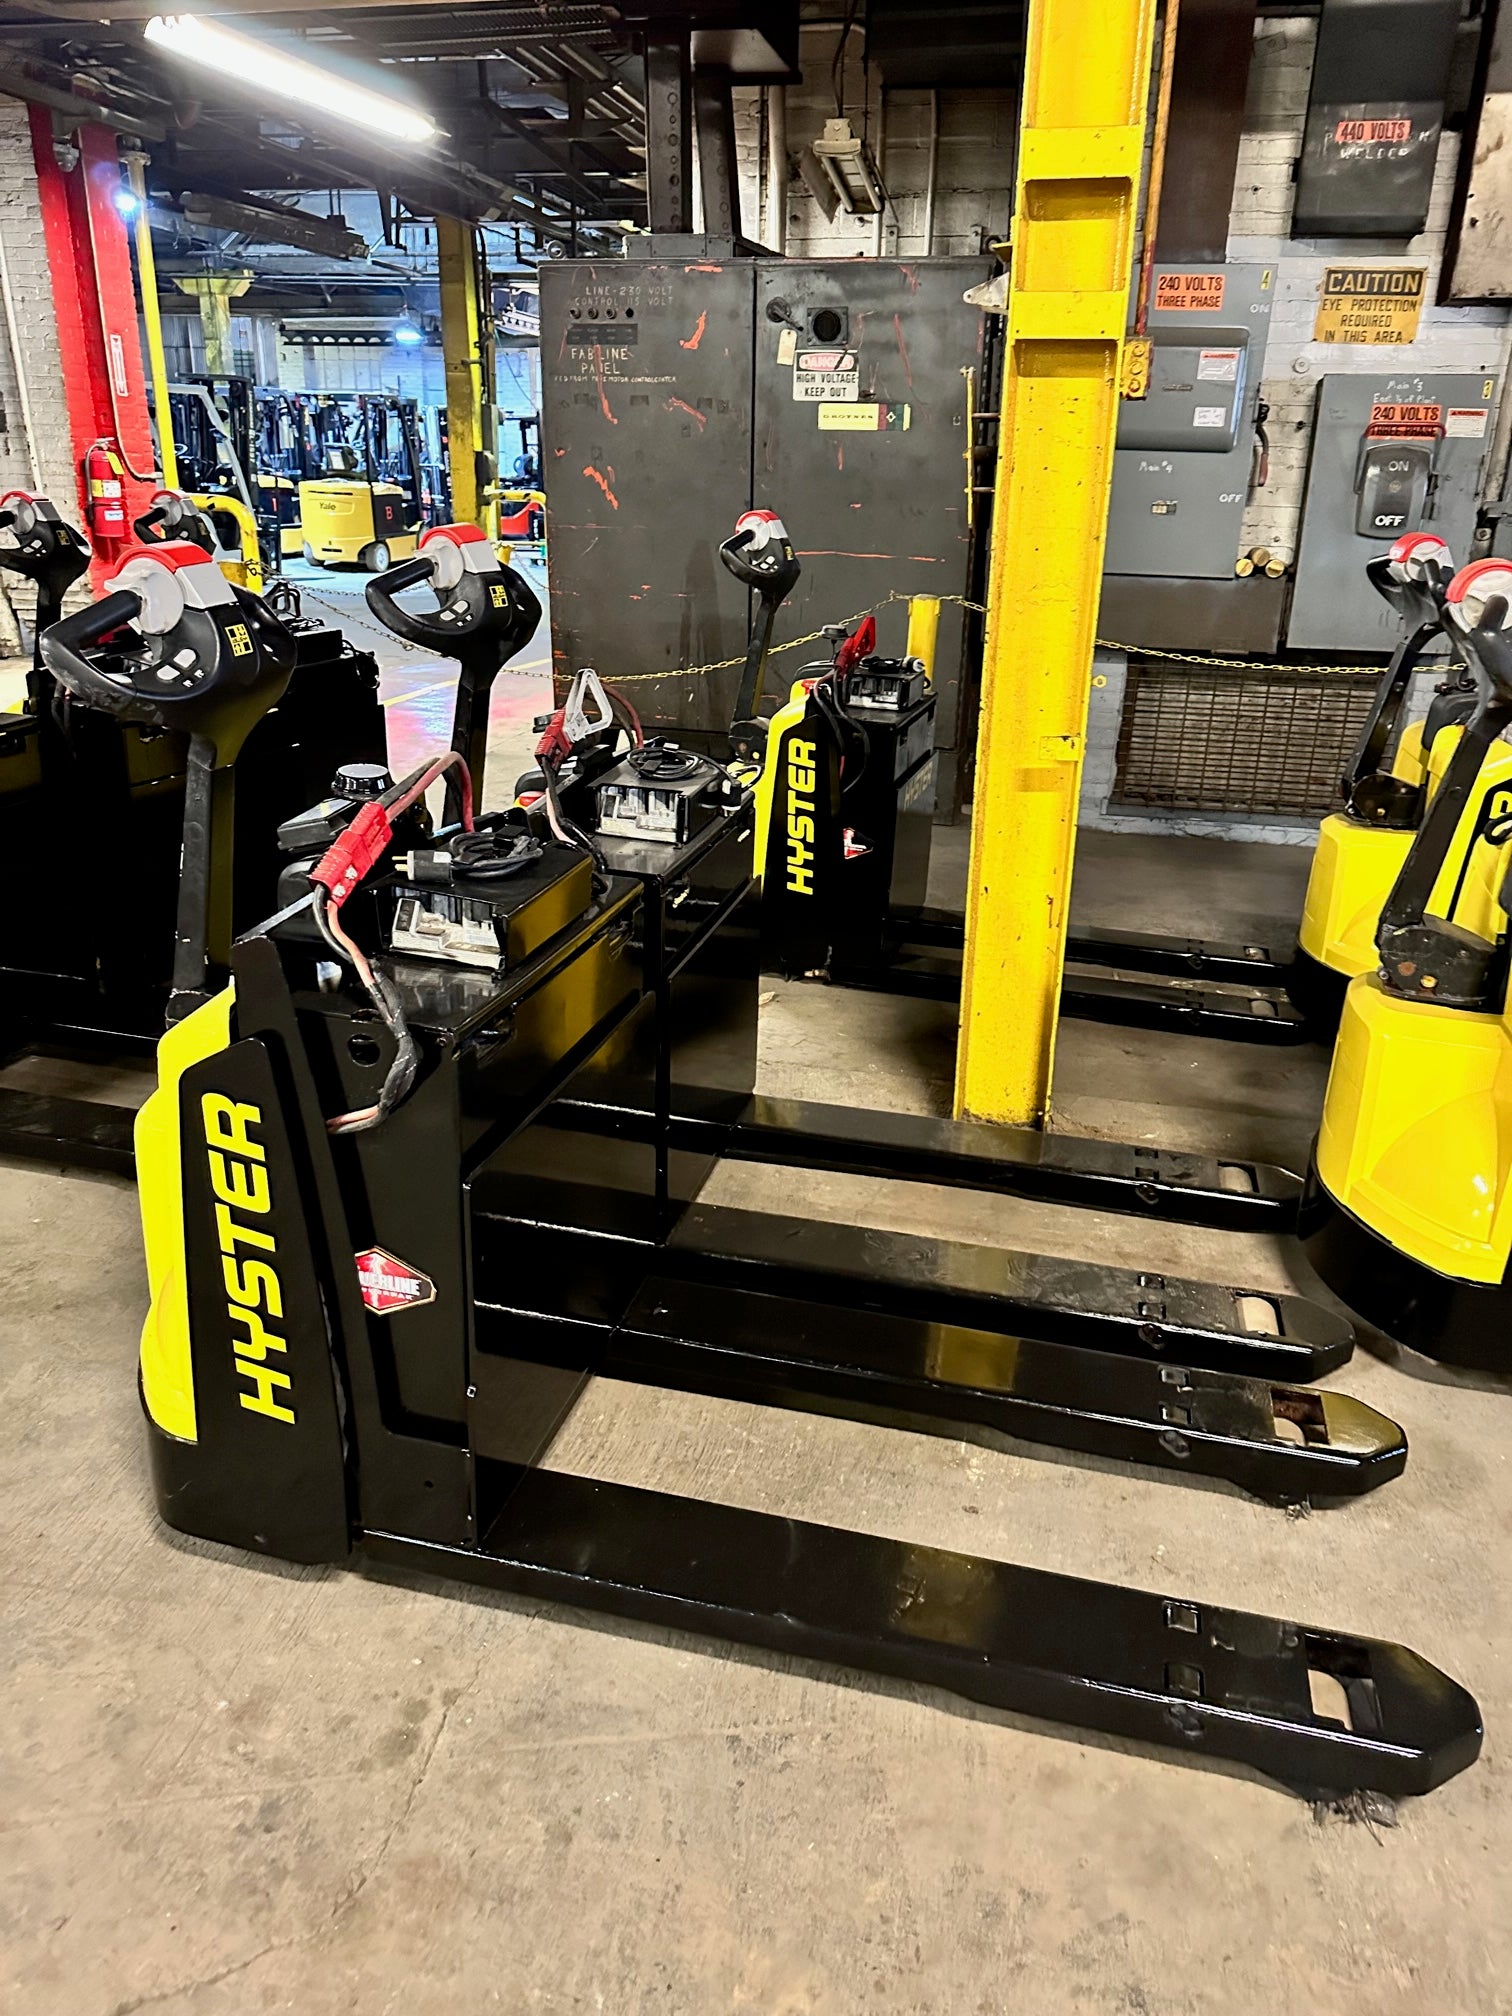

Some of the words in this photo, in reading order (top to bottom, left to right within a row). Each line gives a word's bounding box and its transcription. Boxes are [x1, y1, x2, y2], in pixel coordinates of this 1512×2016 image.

[1340, 122, 1365, 140] 440
[1370, 121, 1406, 140] VOLTS
[1159, 276, 1180, 291] 240
[1185, 276, 1223, 291] VOLTS
[1328, 273, 1420, 293] CAUTION
[648, 285, 674, 296] VOLT
[574, 297, 620, 306] CONTROL
[648, 296, 674, 306] VOLT
[1157, 295, 1187, 308] THREE
[1189, 295, 1221, 308] PHASE
[1321, 298, 1343, 312] EYE
[1350, 299, 1418, 313] PROTECTION
[1249, 303, 1271, 314] ON
[1340, 314, 1393, 328] REQUIRED
[1323, 330, 1336, 342] IN
[1343, 330, 1368, 343] THIS
[1373, 331, 1403, 344] AREA
[571, 347, 595, 360] FAB
[600, 347, 628, 360] LINE
[796, 373, 816, 383] HIGH
[821, 373, 857, 384] VOLTAGE
[804, 387, 826, 397] KEEP
[829, 387, 848, 397] OUT
[1373, 406, 1396, 421] 240
[1400, 406, 1440, 421] VOLTS
[1388, 460, 1410, 472] ON
[1218, 493, 1243, 504] OFF
[319, 502, 337, 511] Yale
[1374, 514, 1405, 527] OFF
[787, 737, 816, 895] HYSTER
[201, 1092, 296, 1425] HYSTER
